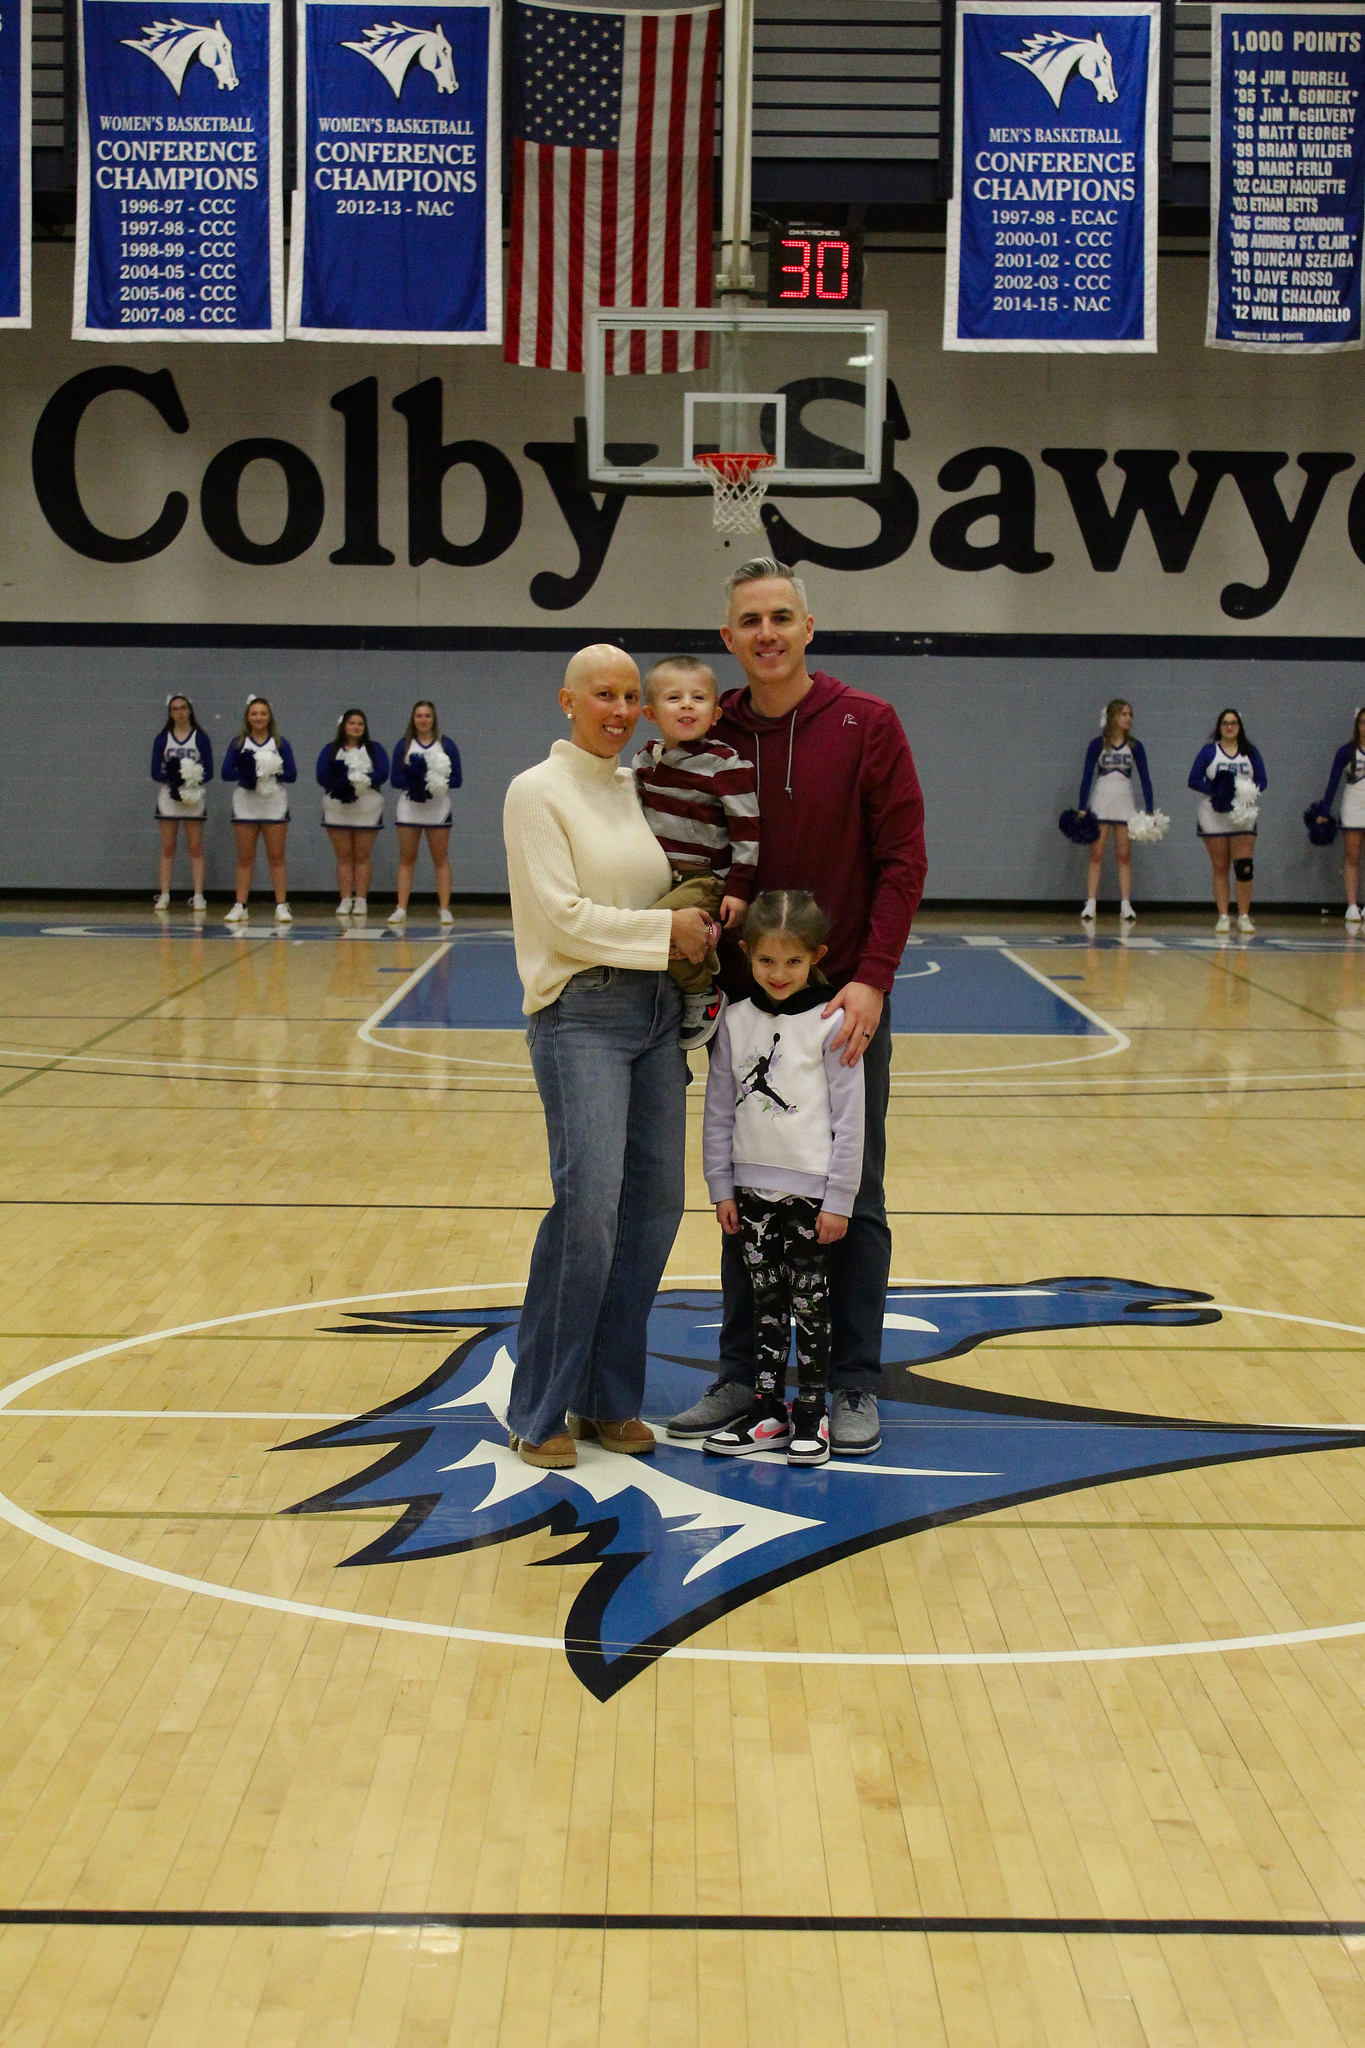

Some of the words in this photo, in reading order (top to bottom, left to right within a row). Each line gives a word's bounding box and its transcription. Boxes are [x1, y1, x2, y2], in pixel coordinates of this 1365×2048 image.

[1232, 30, 1283, 54] 1,000
[1293, 31, 1361, 53] POINTS
[1234, 70, 1256, 85] '94
[1261, 70, 1286, 85] JIM
[1292, 70, 1349, 86] DURRELL
[1234, 88, 1256, 104] '95
[1262, 88, 1274, 104] T.
[1280, 88, 1293, 104] J.
[1234, 107, 1254, 122] '96
[1260, 107, 1283, 122] JIM
[1289, 107, 1356, 123] McGILVERY
[99, 115, 164, 132] WOMEN'S
[166, 116, 255, 133] BASKETBALL
[317, 117, 383, 134] WOMEN'S
[386, 118, 474, 135] BASKETBALL
[1233, 125, 1254, 139] '98
[1258, 125, 1294, 140] MATT
[989, 127, 1032, 143] MEN'S
[1035, 127, 1123, 144] BASKETBALL
[96, 139, 258, 162] CONFERENCE
[315, 141, 477, 165] CONFERENCE
[1233, 143, 1254, 158] '99
[1257, 143, 1297, 158] BRIAN
[1302, 143, 1352, 158] WILDER
[975, 151, 1136, 174] CONFERENCE
[1233, 160, 1254, 176] '99
[1258, 161, 1294, 176] MARC
[1296, 161, 1332, 176] FERLO
[95, 166, 259, 191] CHAMPIONS
[314, 167, 477, 193] CHAMPIONS
[1252, 179, 1288, 194] CALEN
[1290, 179, 1346, 195] PAQUETTE
[973, 177, 1136, 202] CHAMPIONS
[120, 199, 184, 214] 1996-97
[199, 198, 236, 215] CCC
[336, 199, 402, 216] 2012-13
[416, 200, 454, 217] NAC
[1250, 196, 1284, 212] ETHAN
[1286, 197, 1318, 213] BETTS
[992, 209, 1056, 225] 1997-98
[1071, 209, 1118, 226] ECAC
[1254, 216, 1291, 231] CHRIS
[1294, 217, 1344, 232] CONDON
[120, 220, 185, 236] 1997-98
[199, 220, 236, 236] CCC
[994, 231, 1058, 247] 2000-01
[1075, 231, 1113, 247] CCC
[1251, 234, 1297, 249] ANDREW
[1299, 235, 1315, 250] ST.
[121, 242, 185, 258] 1998-99
[199, 241, 236, 258] CCC
[994, 252, 1060, 269] 2001-02
[1074, 252, 1112, 269] CCC
[1253, 252, 1302, 267] DUNCAN
[1305, 253, 1354, 268] SZELIGA
[119, 264, 185, 280] 2004-05
[199, 263, 236, 280] CCC
[779, 240, 850, 299] 30
[1254, 269, 1288, 285] DAVE
[1292, 271, 1333, 286] ROSSO
[994, 274, 1059, 290] 2002-03
[1074, 274, 1111, 290] CCC
[120, 285, 185, 301] 2005-06
[199, 284, 237, 302] CCC
[1253, 287, 1278, 303] JON
[1282, 289, 1340, 305] CHALOUX
[993, 296, 1058, 312] 2014-15
[1074, 296, 1111, 312] NAC
[120, 307, 186, 323] 2007-08
[199, 306, 237, 323] CCC
[1232, 304, 1249, 319] '12
[1251, 306, 1279, 321] WILL
[1282, 307, 1351, 322] BARDAGLIO
[759, 377, 1365, 620] Sawy
[1101, 753, 1132, 766] CSC
